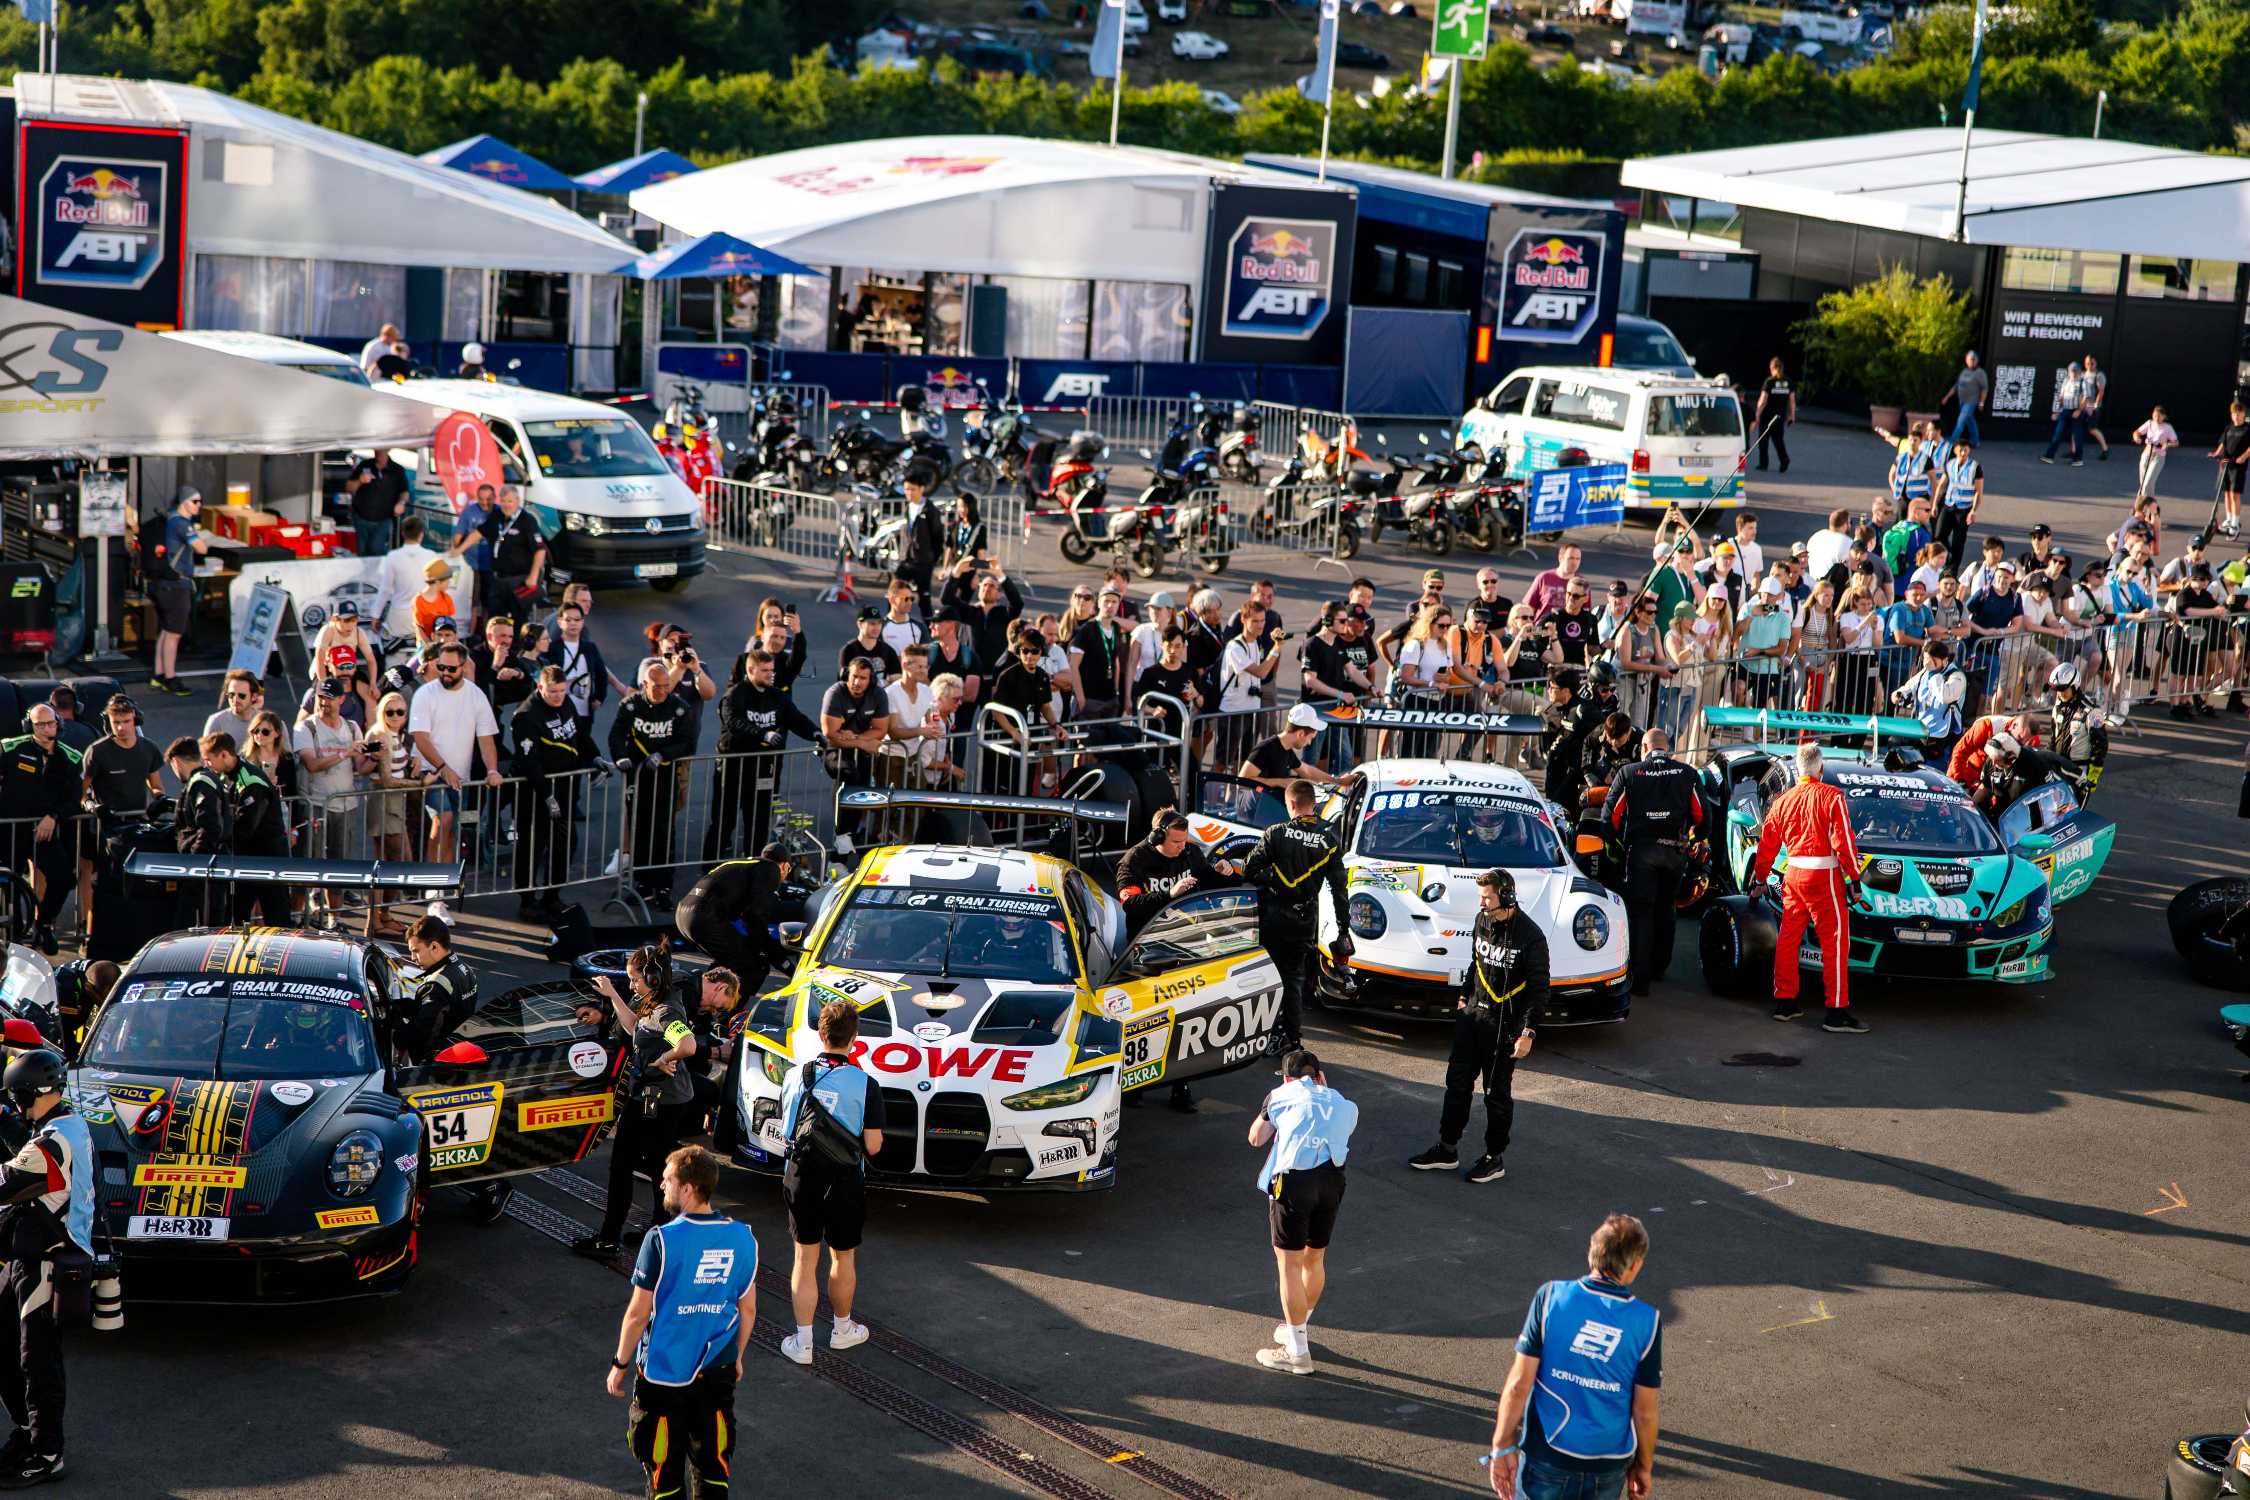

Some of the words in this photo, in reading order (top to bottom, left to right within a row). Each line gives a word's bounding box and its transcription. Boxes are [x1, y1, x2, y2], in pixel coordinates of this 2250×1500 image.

[56, 197, 99, 224] Red
[101, 200, 149, 227] Bull
[56, 230, 148, 268] ABT
[1241, 256, 1281, 280] Red
[1281, 259, 1320, 283] Bull
[1515, 262, 1552, 287] Red
[1553, 265, 1590, 289] Bull
[1238, 286, 1317, 320] ABT
[1512, 294, 1587, 326] ABT
[2004, 310, 2030, 323] WIR
[2034, 312, 2103, 328] BEWEGEN
[2002, 325, 2026, 338] DIE
[2029, 326, 2083, 340] REGION
[1043, 373, 1110, 402] ABT
[634, 717, 672, 736] ROWE
[747, 711, 776, 725] ROWE
[1455, 794, 1487, 806] GRAN
[1490, 797, 1540, 815] TURISMO
[1878, 789, 1910, 799] GRAN
[1911, 791, 1962, 803] TURISMO
[1285, 827, 1321, 844] ROWE
[143, 864, 449, 883] PORSCHE
[944, 895, 984, 907] GRAN
[987, 897, 1050, 914] TURISMO
[232, 980, 277, 993] GRAN
[283, 982, 353, 1002] TURISMO
[835, 976, 868, 995] 98
[1154, 974, 1206, 1003] Ansys
[269, 993, 303, 1001] DRIVING
[304, 995, 350, 1007] SIMULATOR
[1124, 1014, 1168, 1034] AVENOL
[1177, 987, 1284, 1061] ROW
[1125, 1036, 1149, 1067] 98
[1223, 1032, 1271, 1065] MOTO
[847, 1040, 1034, 1083] ROWE
[421, 1089, 490, 1108] RAVENOL
[526, 1099, 606, 1126] PIRELLI
[432, 1111, 467, 1145] 54
[143, 1167, 237, 1184] PIRELLI
[322, 1209, 373, 1225] PIRELLI
[1551, 1368, 1622, 1393] SCRUTINEERING
